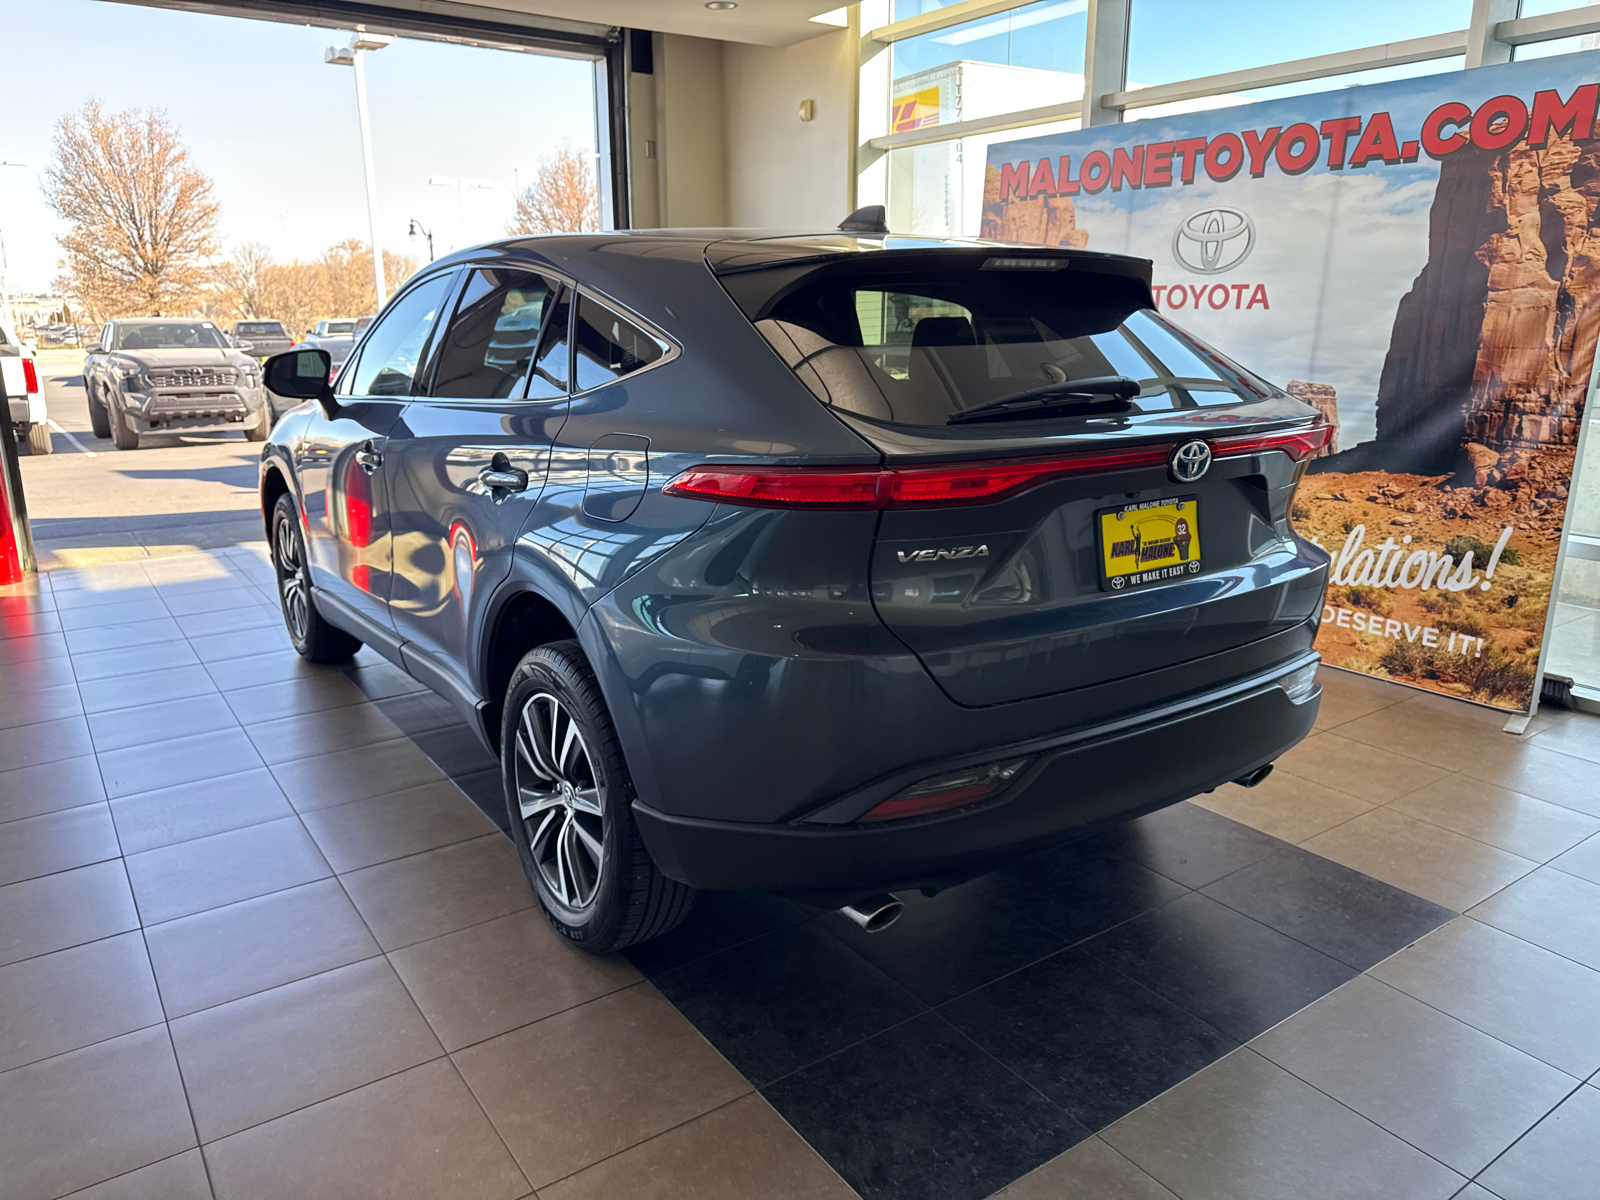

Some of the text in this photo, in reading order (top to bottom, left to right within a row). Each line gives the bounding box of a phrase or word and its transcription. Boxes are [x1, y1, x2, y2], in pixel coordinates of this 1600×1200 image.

[955, 84, 963, 163] T7704
[1000, 83, 1600, 201] MALONETOYOTA.COM
[1151, 283, 1270, 310] TOYOTA
[1139, 501, 1160, 510] MALONE
[1161, 498, 1179, 507] TOYOTA
[1177, 524, 1187, 535] 32
[897, 544, 989, 562] VENZA
[1110, 539, 1136, 559] KARL
[1140, 542, 1175, 563] MALONE
[1310, 524, 1514, 592] lations!
[1130, 565, 1184, 584] WE MAKE IT EASY
[1321, 605, 1484, 658] DESERVE IT!
